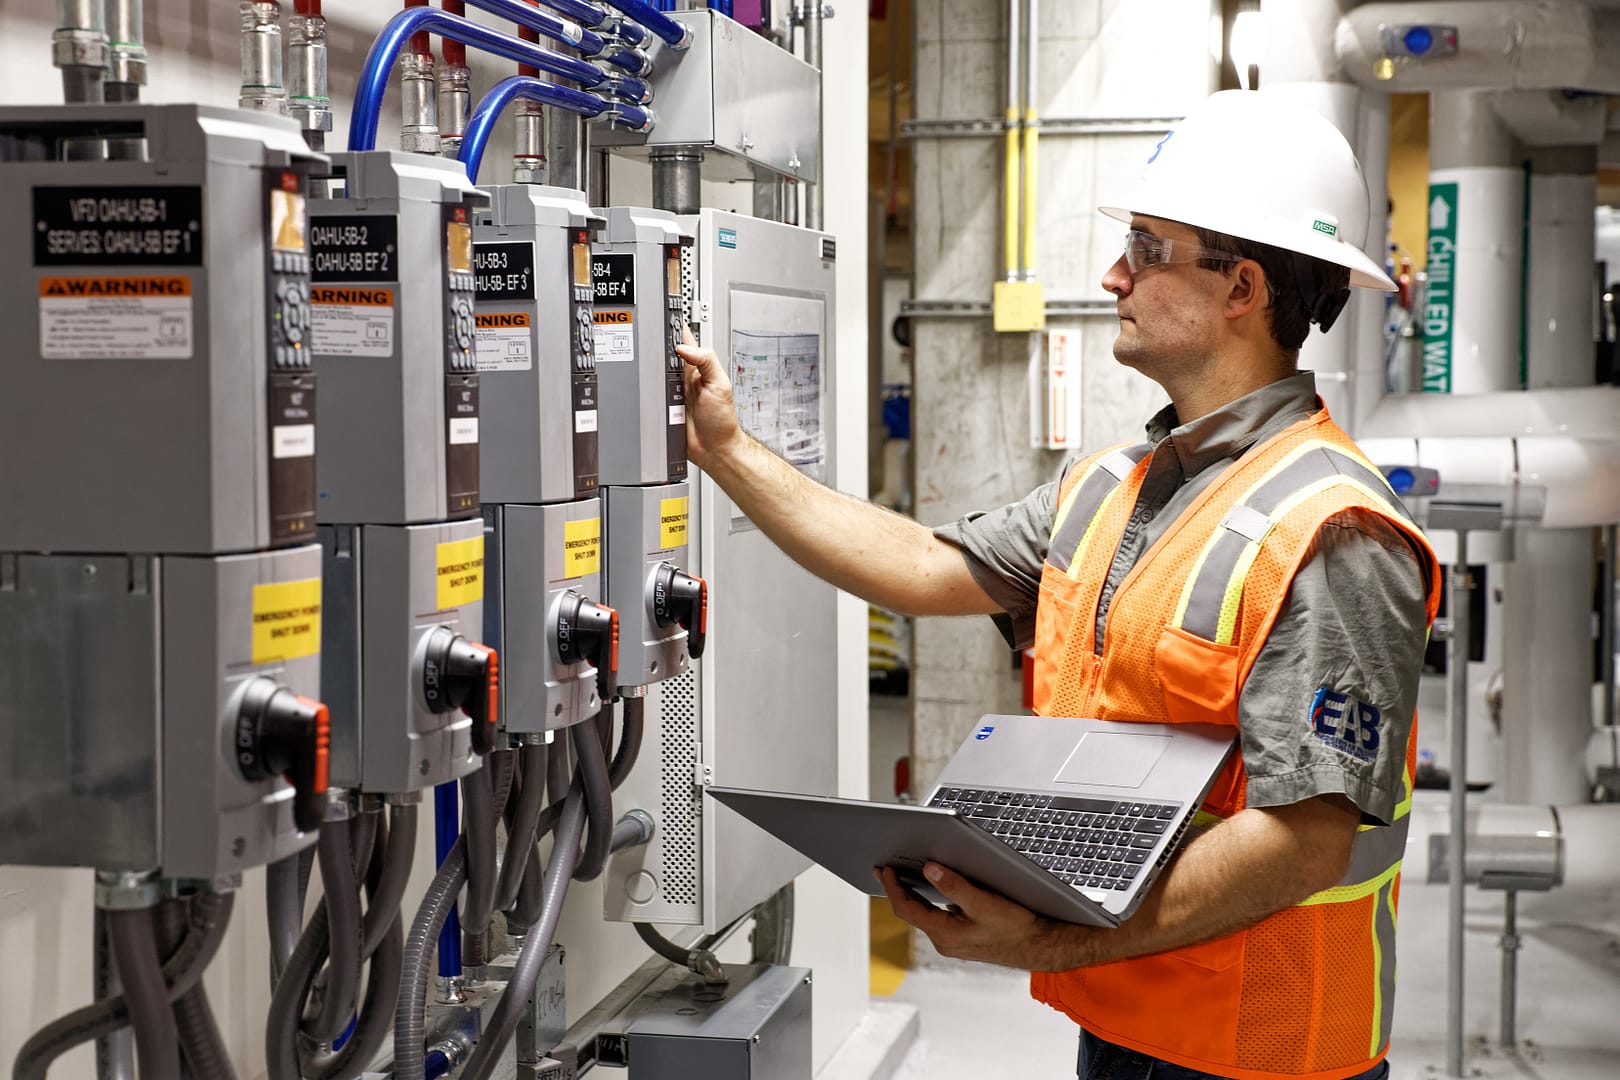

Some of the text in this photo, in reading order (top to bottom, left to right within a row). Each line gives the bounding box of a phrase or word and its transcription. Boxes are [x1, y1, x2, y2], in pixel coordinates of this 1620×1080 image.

[70, 198, 98, 222] VFD
[311, 226, 368, 246] OAHU-5B-2
[1313, 220, 1336, 235] MSA
[163, 229, 181, 254] EF
[183, 230, 191, 253] 1
[315, 252, 363, 272] OAHU-5B
[364, 252, 379, 272] EF
[381, 252, 388, 271] 2
[473, 252, 508, 269] HU-5B-3
[66, 280, 184, 295] WARNING
[507, 274, 519, 290] EF
[520, 274, 527, 290] 3
[608, 282, 620, 296] EF
[620, 282, 627, 296] 4
[311, 289, 388, 304] ARNING
[593, 312, 628, 323] NING
[1423, 235, 1452, 393] CHILLED WAT
[656, 585, 666, 605] OFF
[559, 617, 569, 638] OFF
[426, 660, 438, 685] OFF
[1314, 689, 1381, 751] EAB
